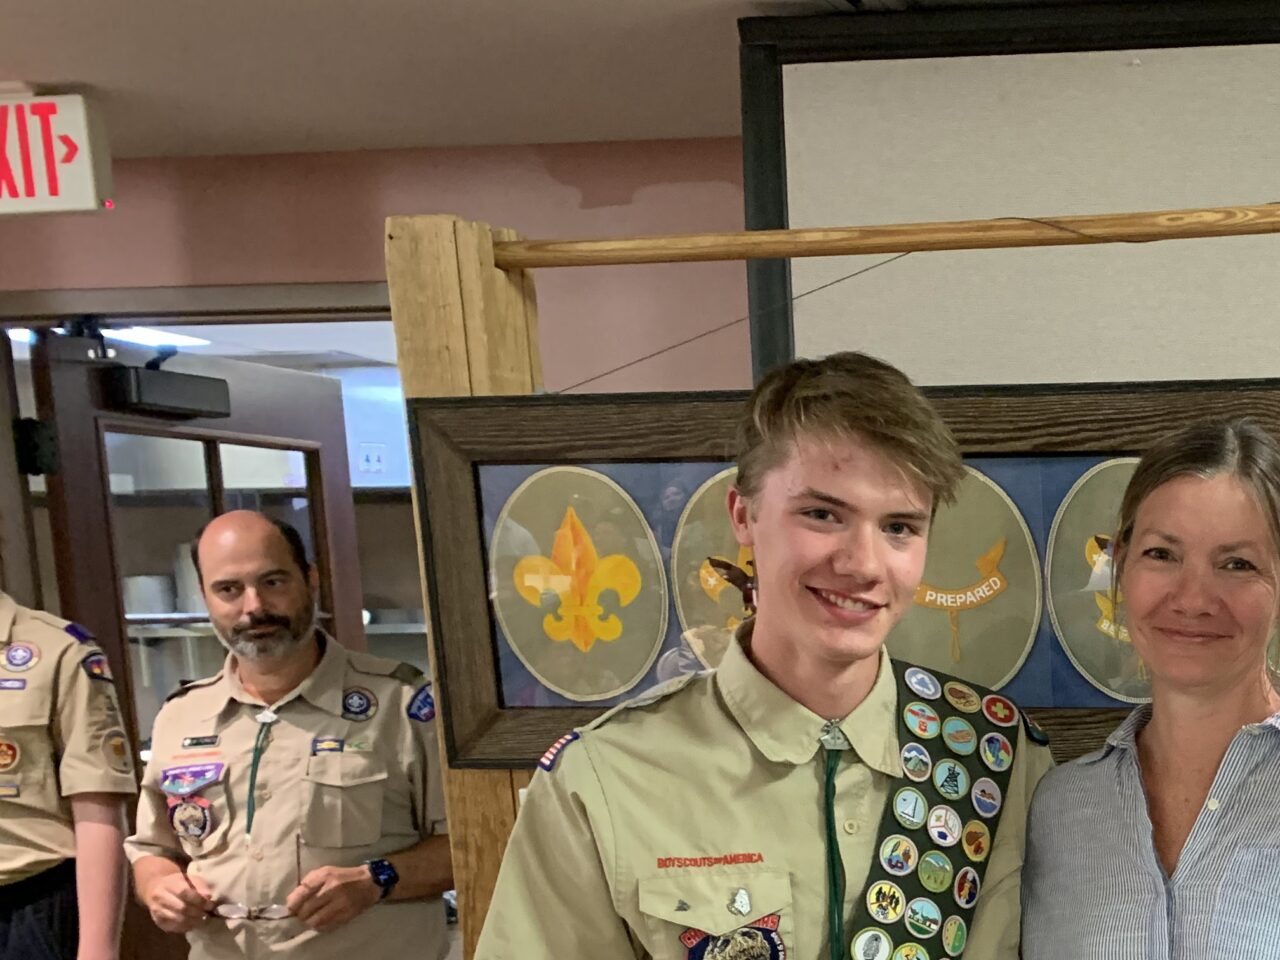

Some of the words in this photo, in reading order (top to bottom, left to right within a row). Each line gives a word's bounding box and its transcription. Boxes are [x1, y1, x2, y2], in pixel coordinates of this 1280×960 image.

[0, 102, 59, 198] XIT
[925, 577, 1001, 607] PREPARED
[722, 852, 764, 865] AMERICA
